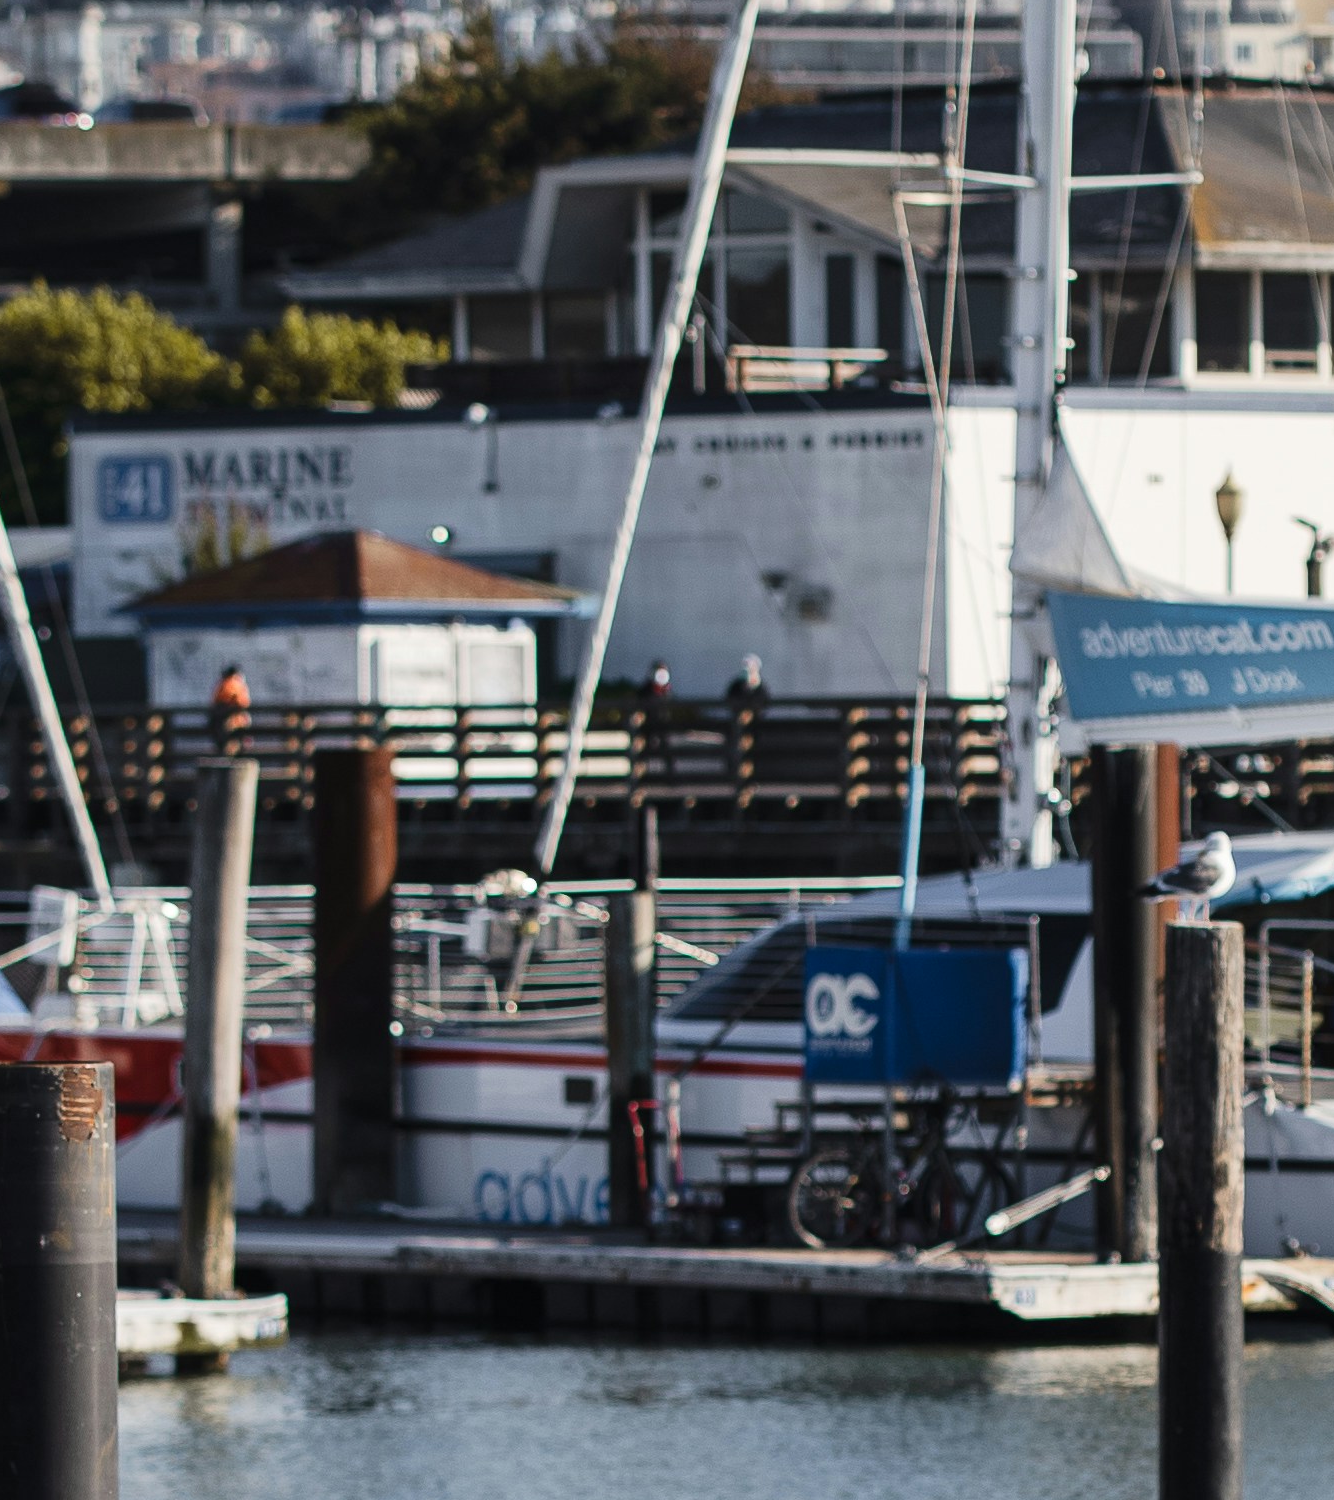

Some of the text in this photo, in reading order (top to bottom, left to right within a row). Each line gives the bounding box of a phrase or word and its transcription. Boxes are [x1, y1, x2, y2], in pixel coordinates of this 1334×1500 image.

[181, 449, 354, 488] MARINE
[1079, 617, 1334, 659] adventurecat.com
[805, 972, 880, 1038] ac
